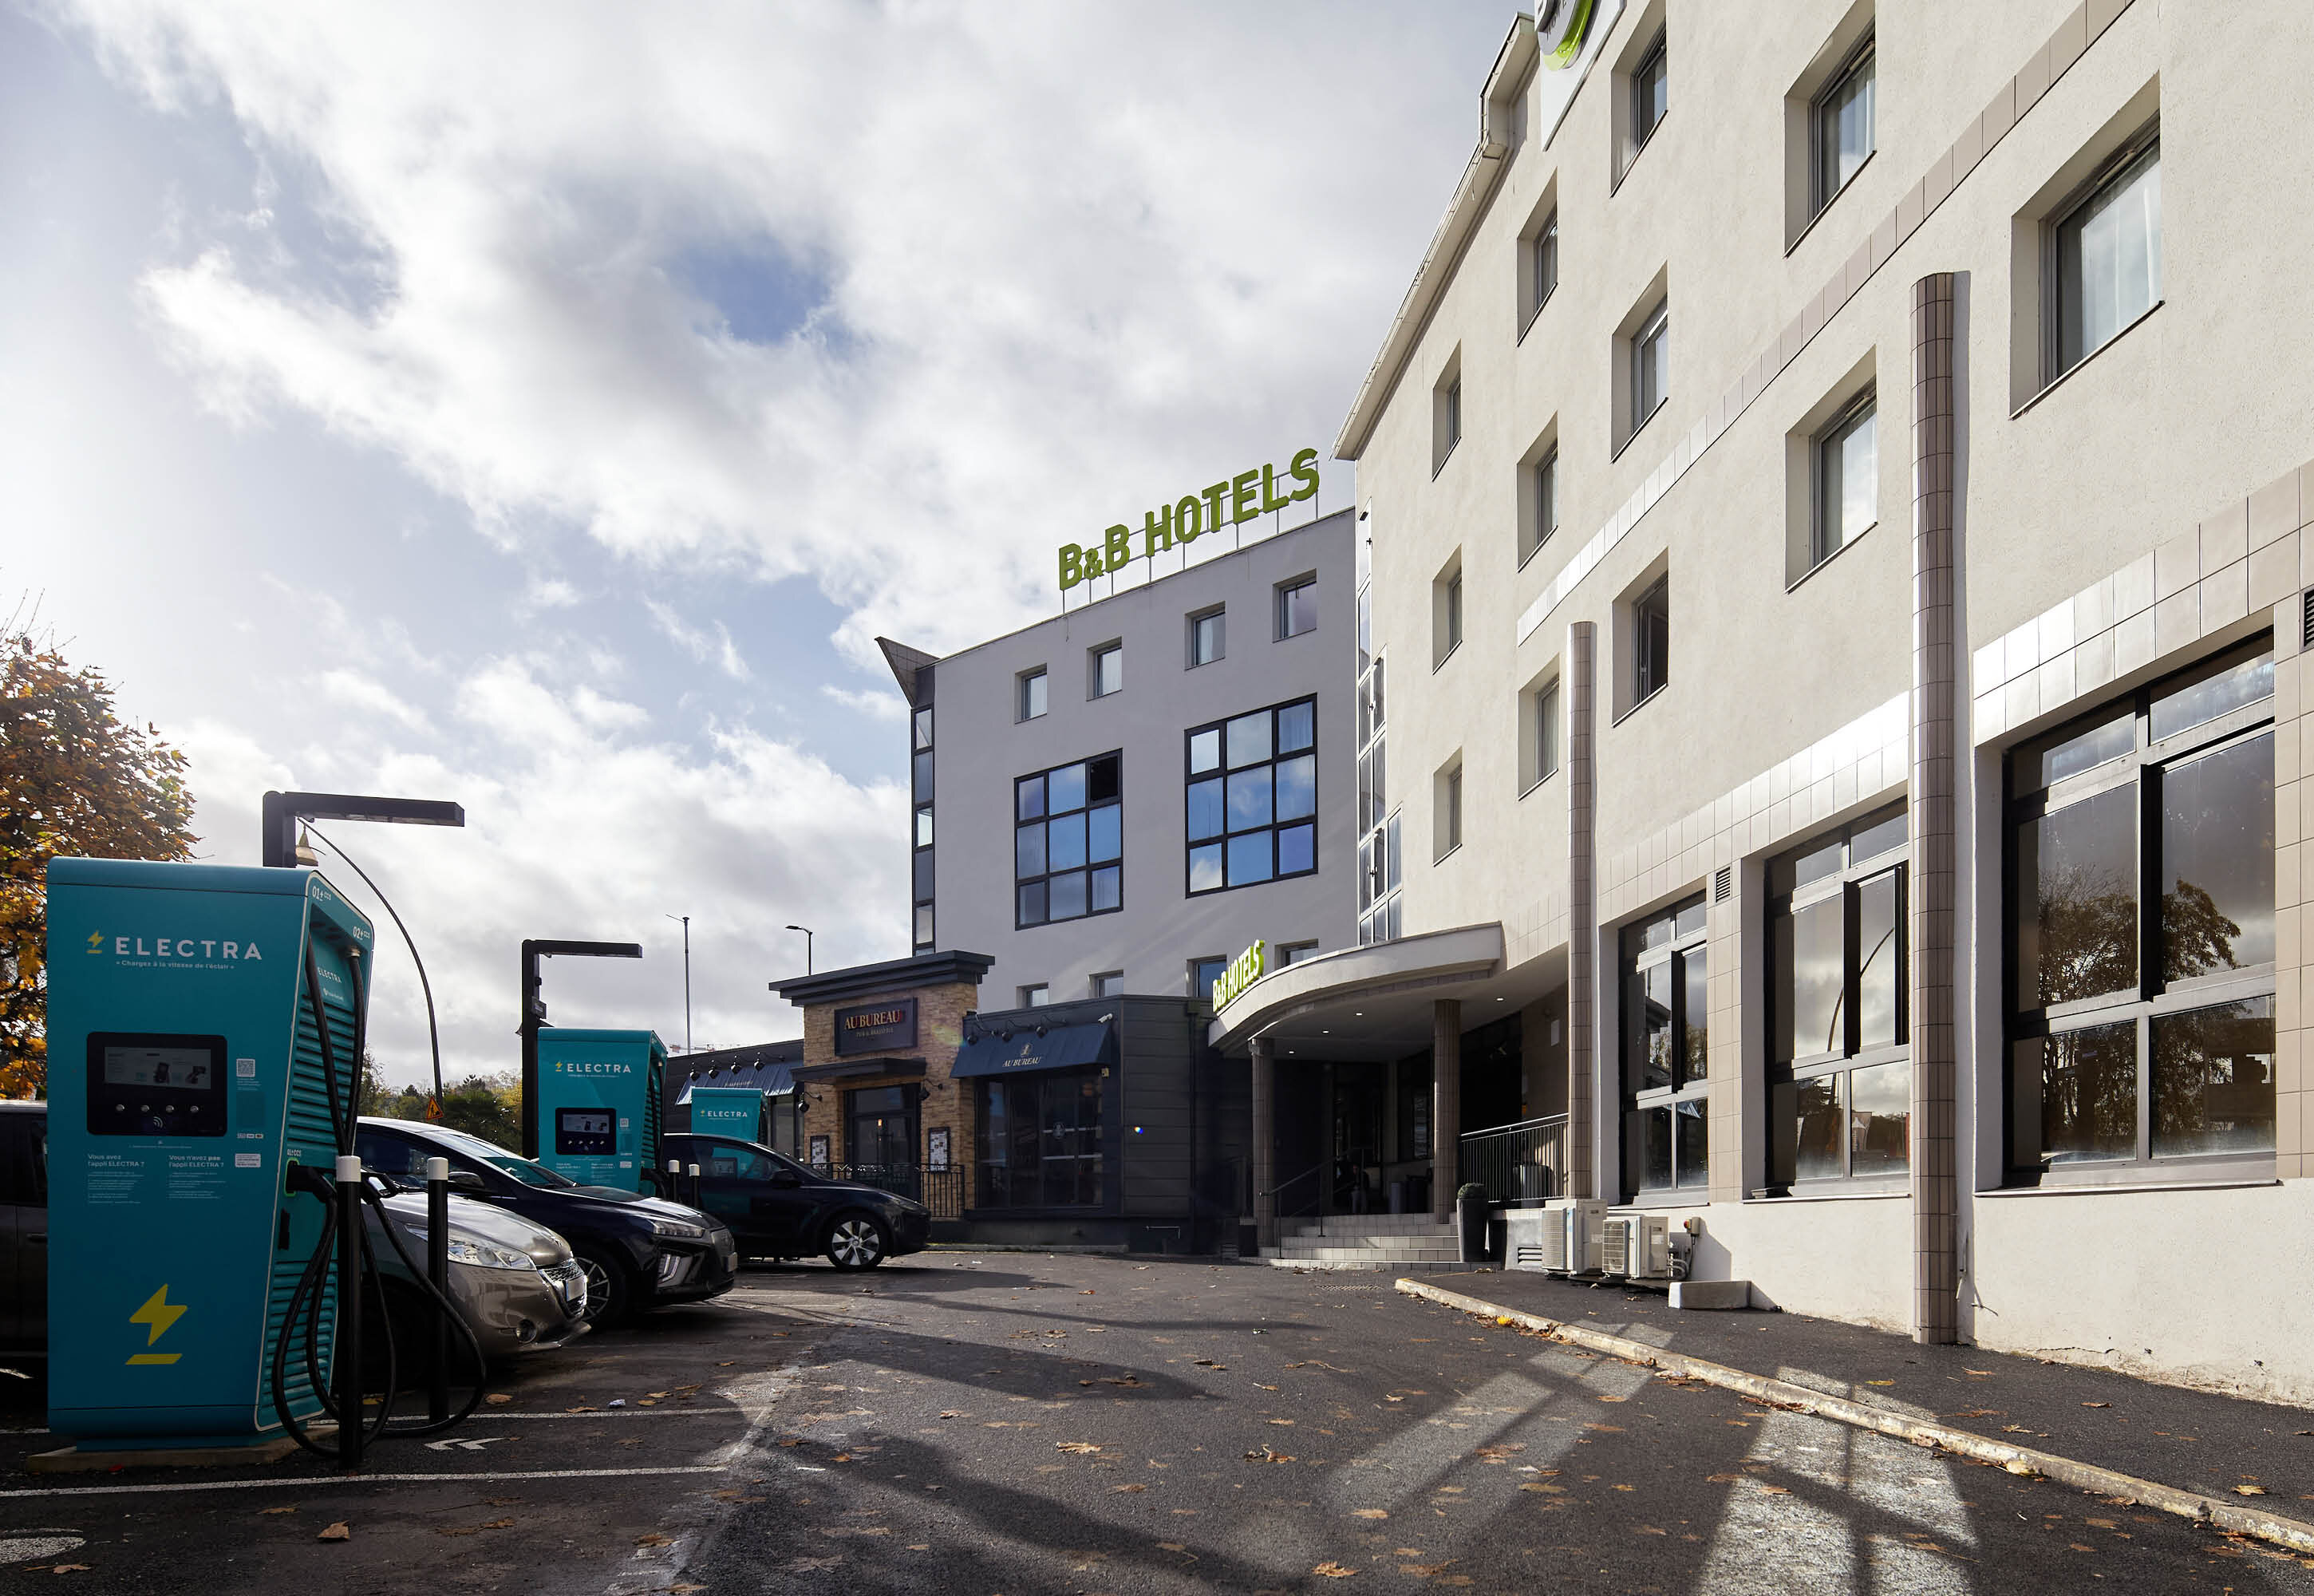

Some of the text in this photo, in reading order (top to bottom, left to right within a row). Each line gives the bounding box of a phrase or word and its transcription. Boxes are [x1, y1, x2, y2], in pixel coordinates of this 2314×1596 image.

[1058, 448, 1320, 591] B&B HOTELS
[115, 936, 263, 961] ELECTRA
[121, 959, 151, 968] Chargez
[318, 966, 342, 983] ELECTRA
[1213, 939, 1265, 1013] B&B HOTELS
[844, 1009, 901, 1029] AU BUREAU
[567, 1063, 631, 1073] ELECTRA
[1013, 1057, 1041, 1066] BUREAU
